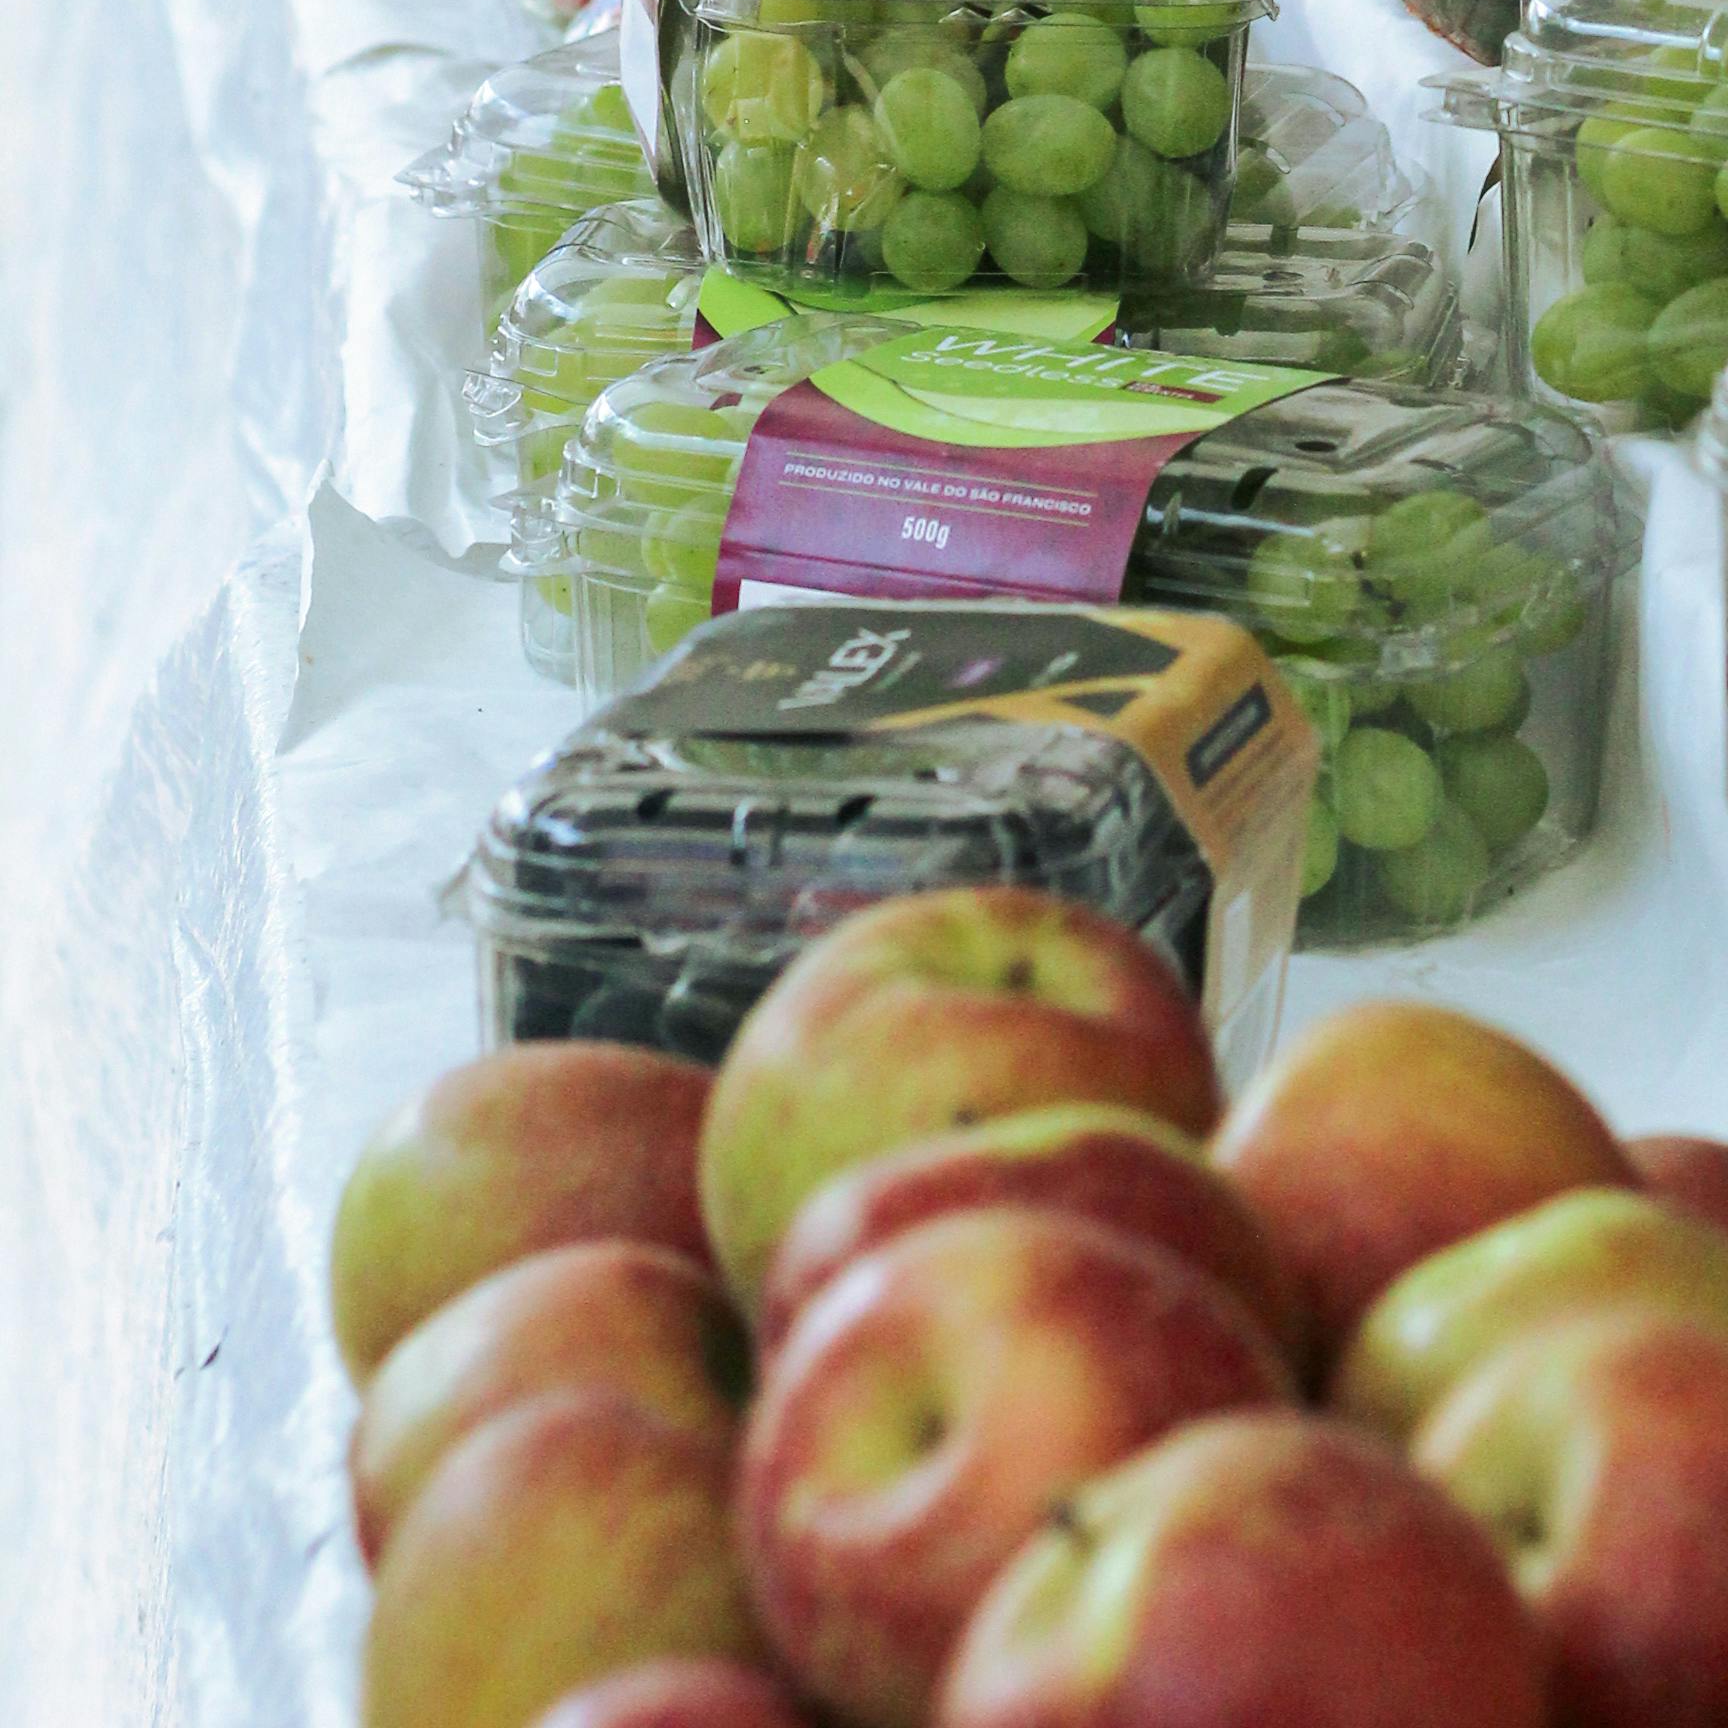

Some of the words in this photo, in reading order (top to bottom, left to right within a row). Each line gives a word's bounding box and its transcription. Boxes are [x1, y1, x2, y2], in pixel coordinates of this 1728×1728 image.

[901, 350, 1124, 389] Seedless
[936, 335, 1270, 392] WHITE
[784, 463, 875, 486] PRODUZIDO
[877, 475, 901, 489] NO
[903, 479, 941, 494] VALE
[943, 484, 968, 499] DO
[969, 485, 999, 502] SÃO
[1002, 491, 1093, 516] FRANCISCO
[902, 516, 951, 549] 500g
